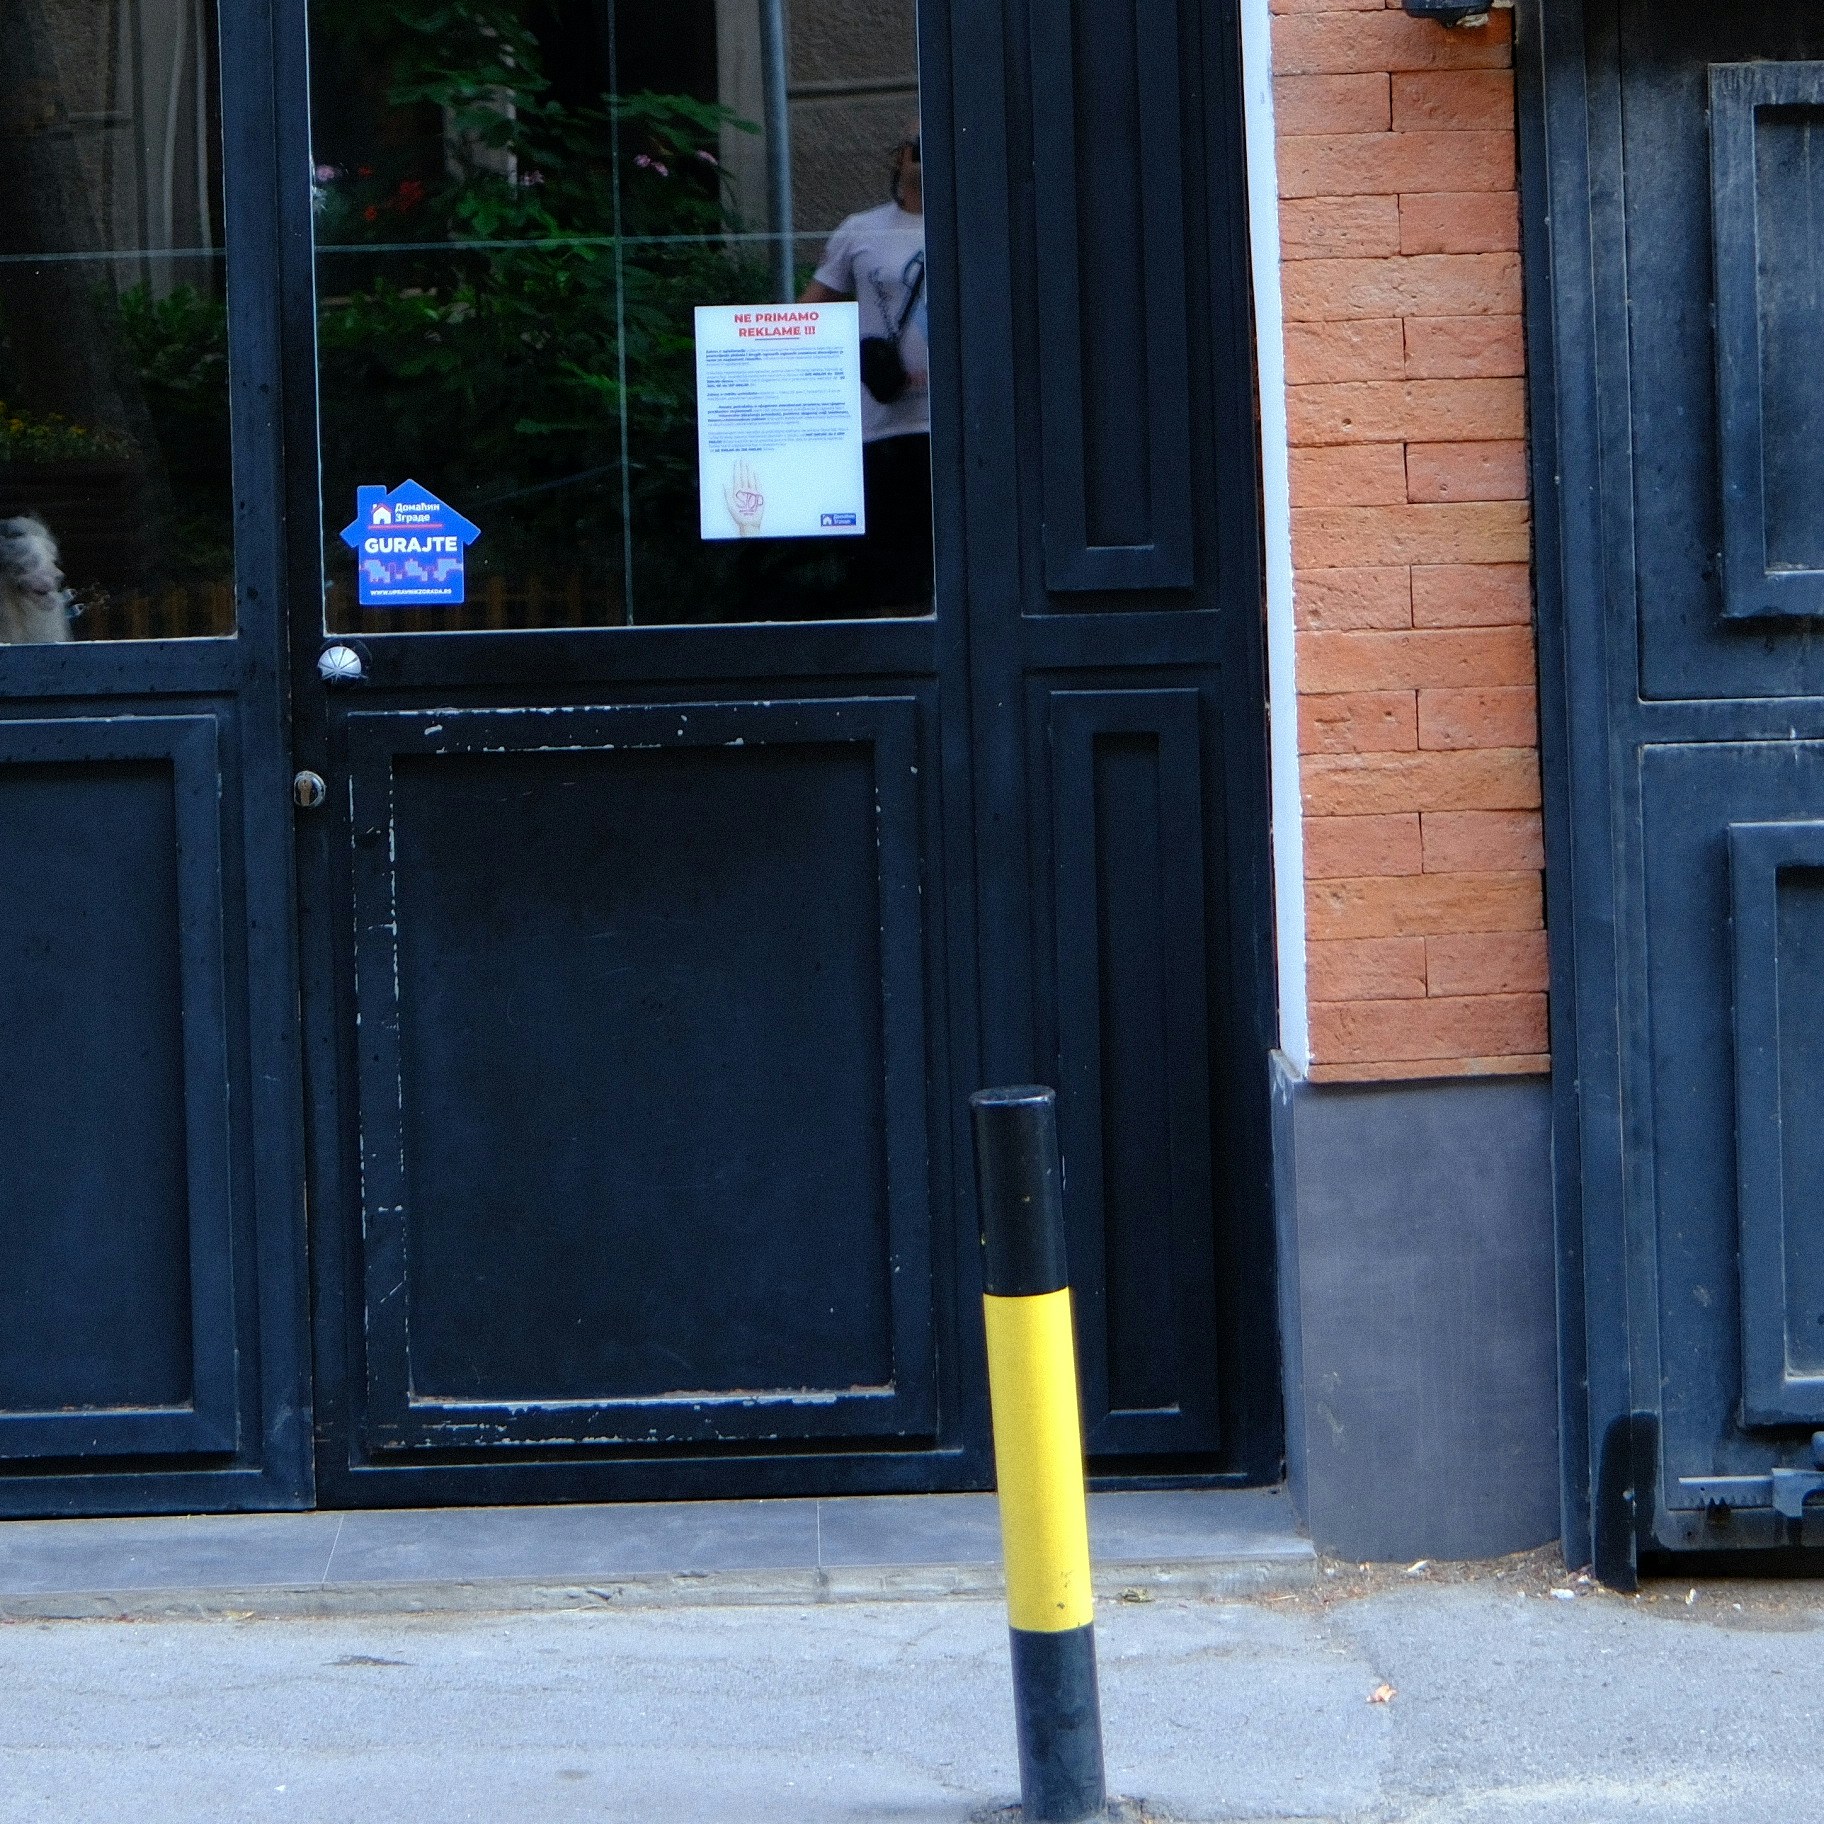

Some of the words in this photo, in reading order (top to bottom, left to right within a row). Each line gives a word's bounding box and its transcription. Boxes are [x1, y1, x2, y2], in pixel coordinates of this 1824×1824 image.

[734, 313, 752, 324] NE
[755, 311, 820, 323] PRIMAMO
[738, 326, 801, 338] REKLAME
[804, 325, 816, 336] !!!
[395, 502, 440, 514] Домаћин
[395, 513, 431, 524] Зграде
[364, 536, 458, 554] GURAJTE
